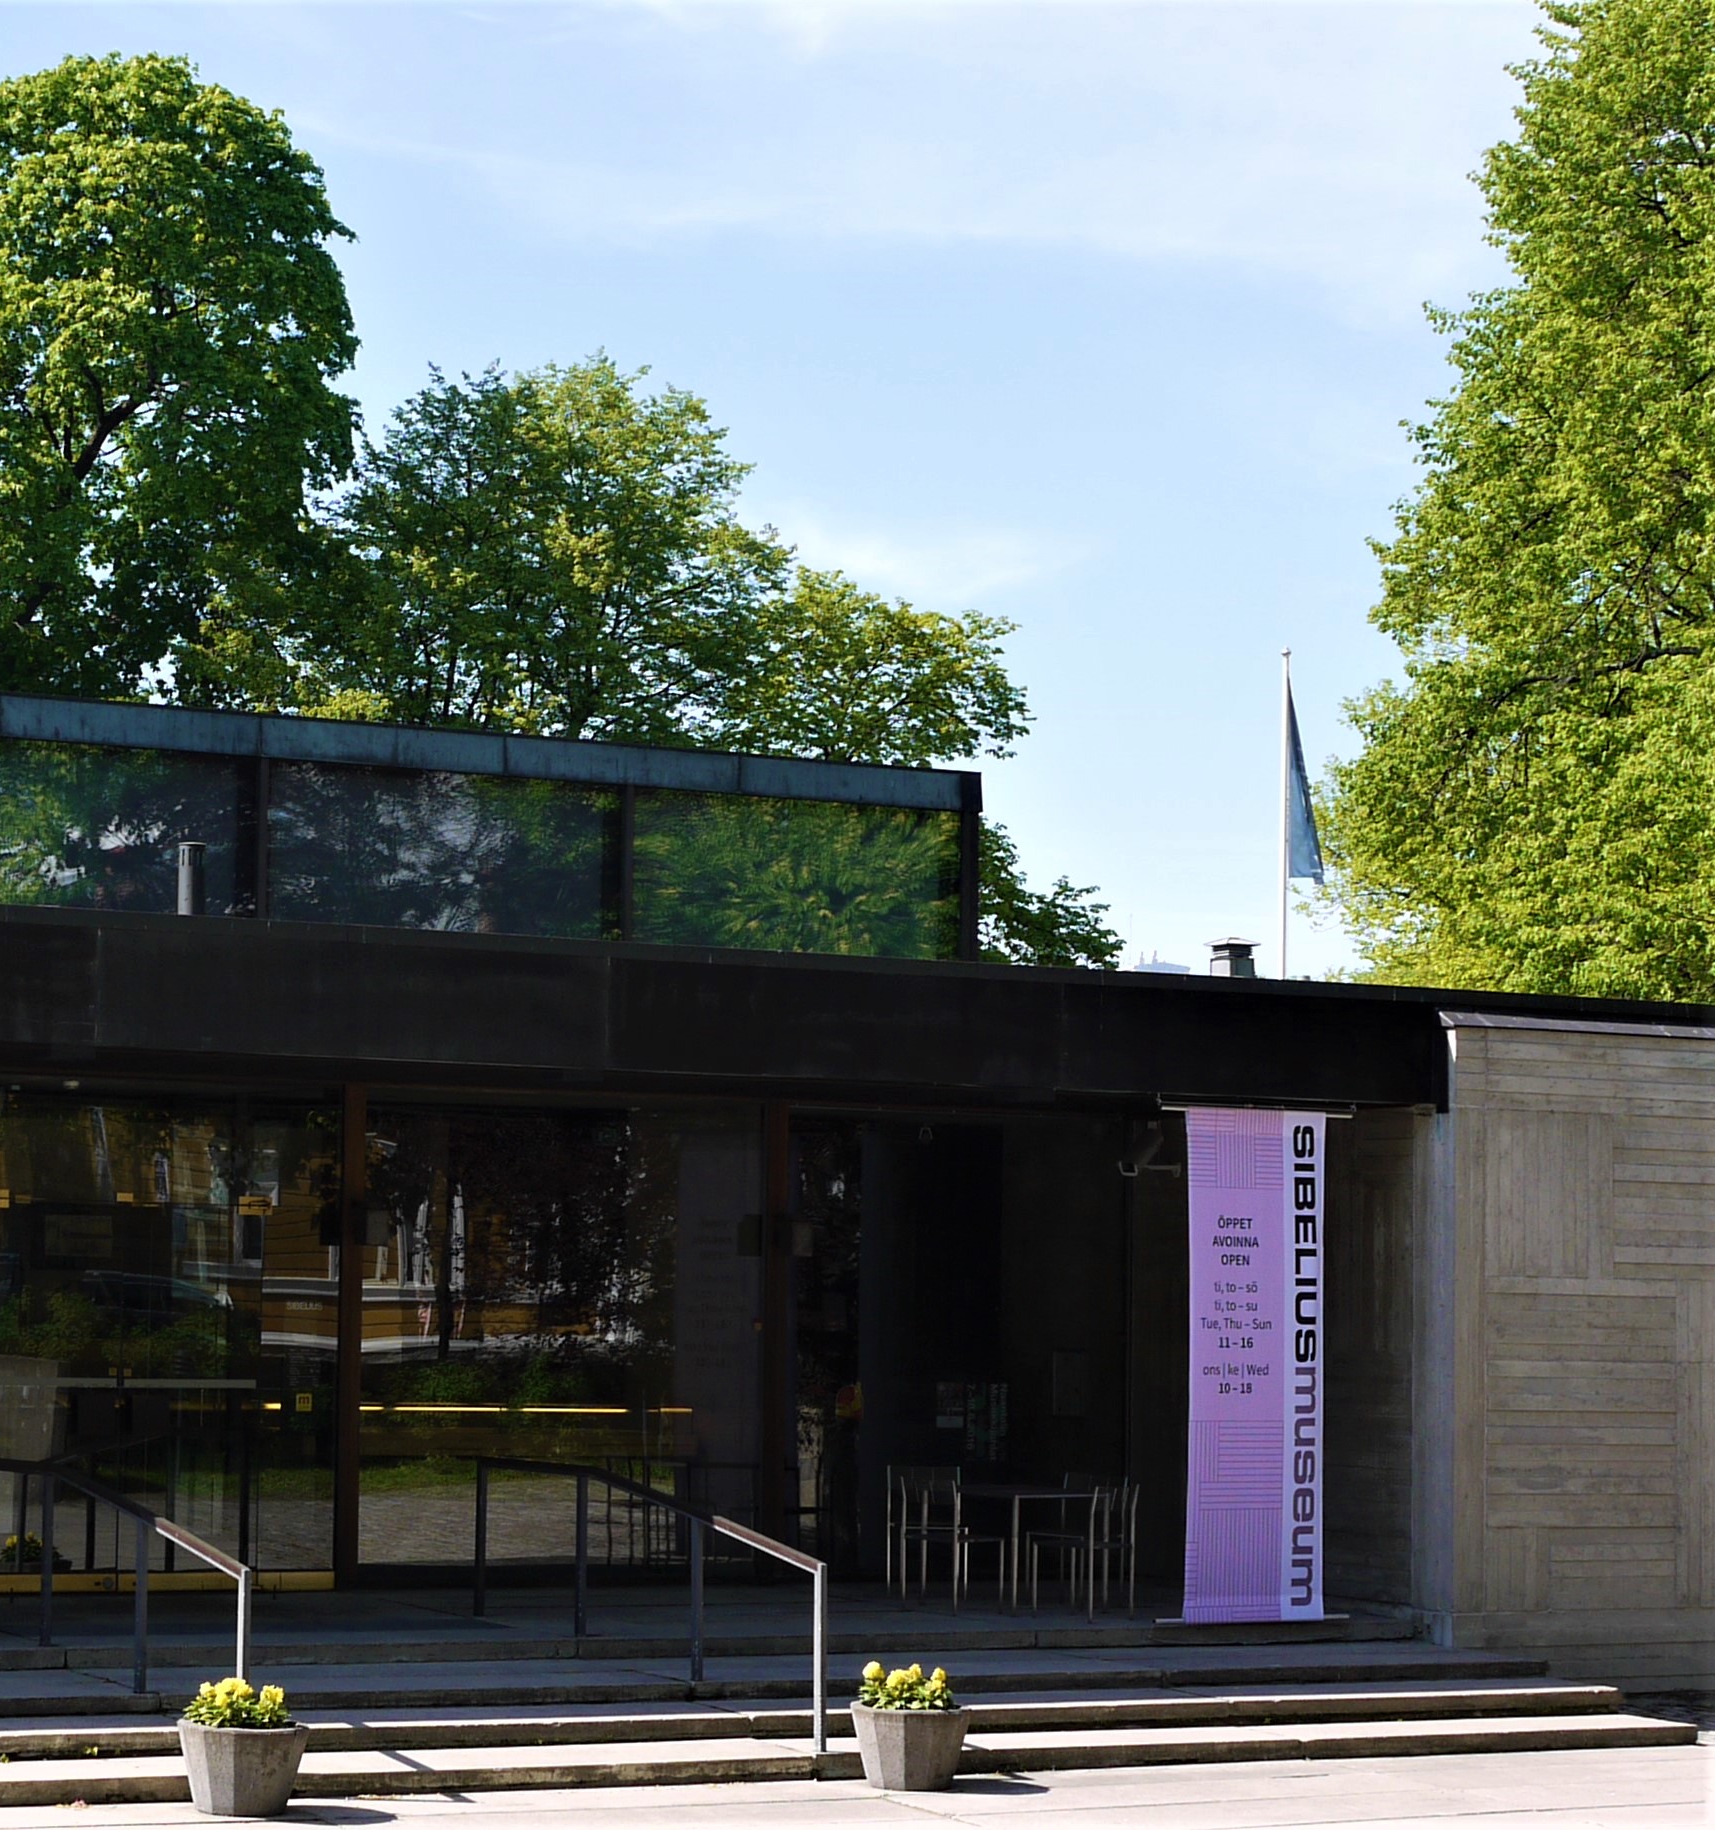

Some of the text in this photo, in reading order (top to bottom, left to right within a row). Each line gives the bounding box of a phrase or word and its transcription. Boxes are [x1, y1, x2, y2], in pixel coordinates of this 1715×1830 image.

[1218, 1215, 1253, 1229] ÖPPET
[1212, 1236, 1259, 1248] AVOINNA
[1221, 1254, 1250, 1266] OPEN
[1214, 1282, 1224, 1295] ti,
[1226, 1282, 1236, 1293] to
[1214, 1300, 1224, 1313] ti,
[1226, 1301, 1236, 1312] to
[1246, 1302, 1258, 1312] su
[1201, 1317, 1221, 1331] Tue,
[1223, 1317, 1243, 1330] Thu
[1252, 1318, 1272, 1330] Sun
[1203, 1365, 1221, 1376] ons
[1228, 1363, 1239, 1375] ke
[1247, 1364, 1269, 1376] Wed
